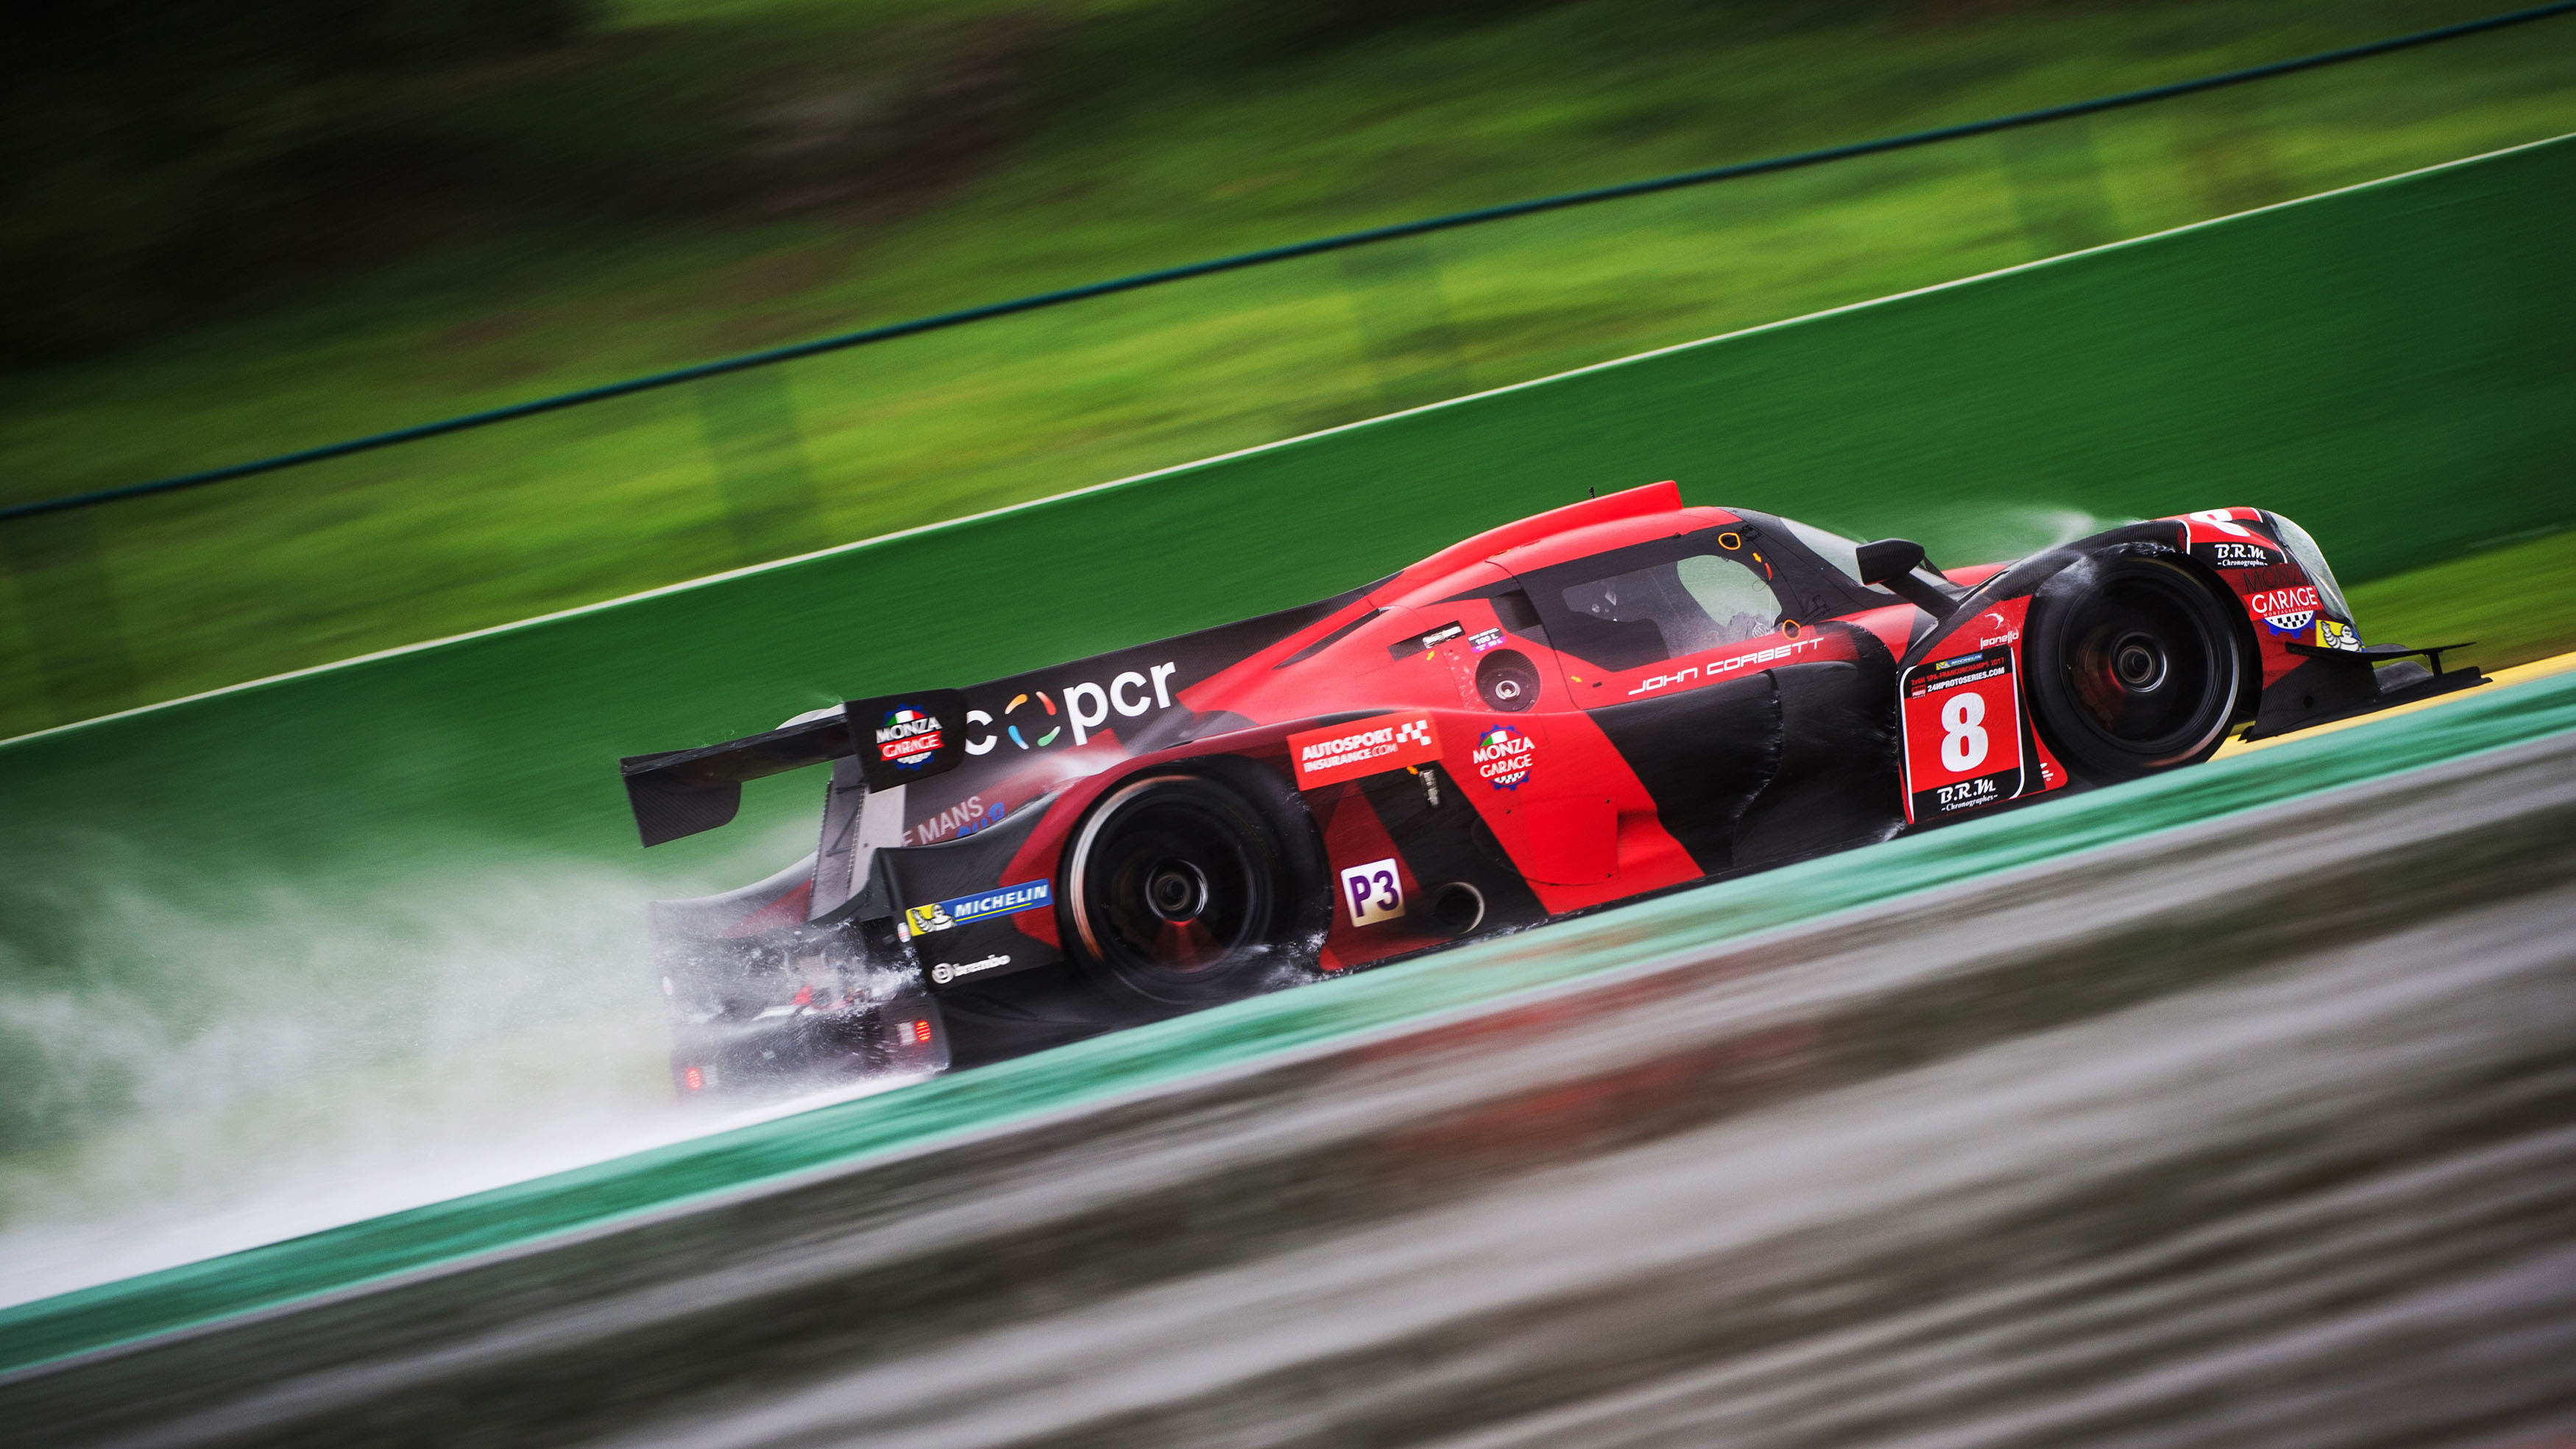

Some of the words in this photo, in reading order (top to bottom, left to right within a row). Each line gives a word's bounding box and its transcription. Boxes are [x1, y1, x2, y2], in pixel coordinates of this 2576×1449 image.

[2243, 565, 2304, 594] MONZ
[2252, 587, 2318, 613] GARAGE
[1628, 667, 1698, 695] JOHN
[1707, 637, 1825, 676] CORBETT
[1951, 654, 1981, 665] MICHELIN
[1927, 667, 2005, 692] 24HPROTOSERIES.COM
[876, 717, 942, 743] MONZA
[1302, 727, 1393, 761] AUTOSPORT
[1941, 692, 1988, 772] 8
[882, 734, 938, 757] GARAGE
[1303, 743, 1398, 773] INSURANCE.COM
[1473, 737, 1535, 764] MONZA
[1479, 754, 1533, 777] GARAGE
[1936, 779, 1996, 804] B.R.M
[917, 796, 984, 845] MANS
[955, 885, 1049, 918] MICHELIN
[1348, 870, 1400, 918] P3
